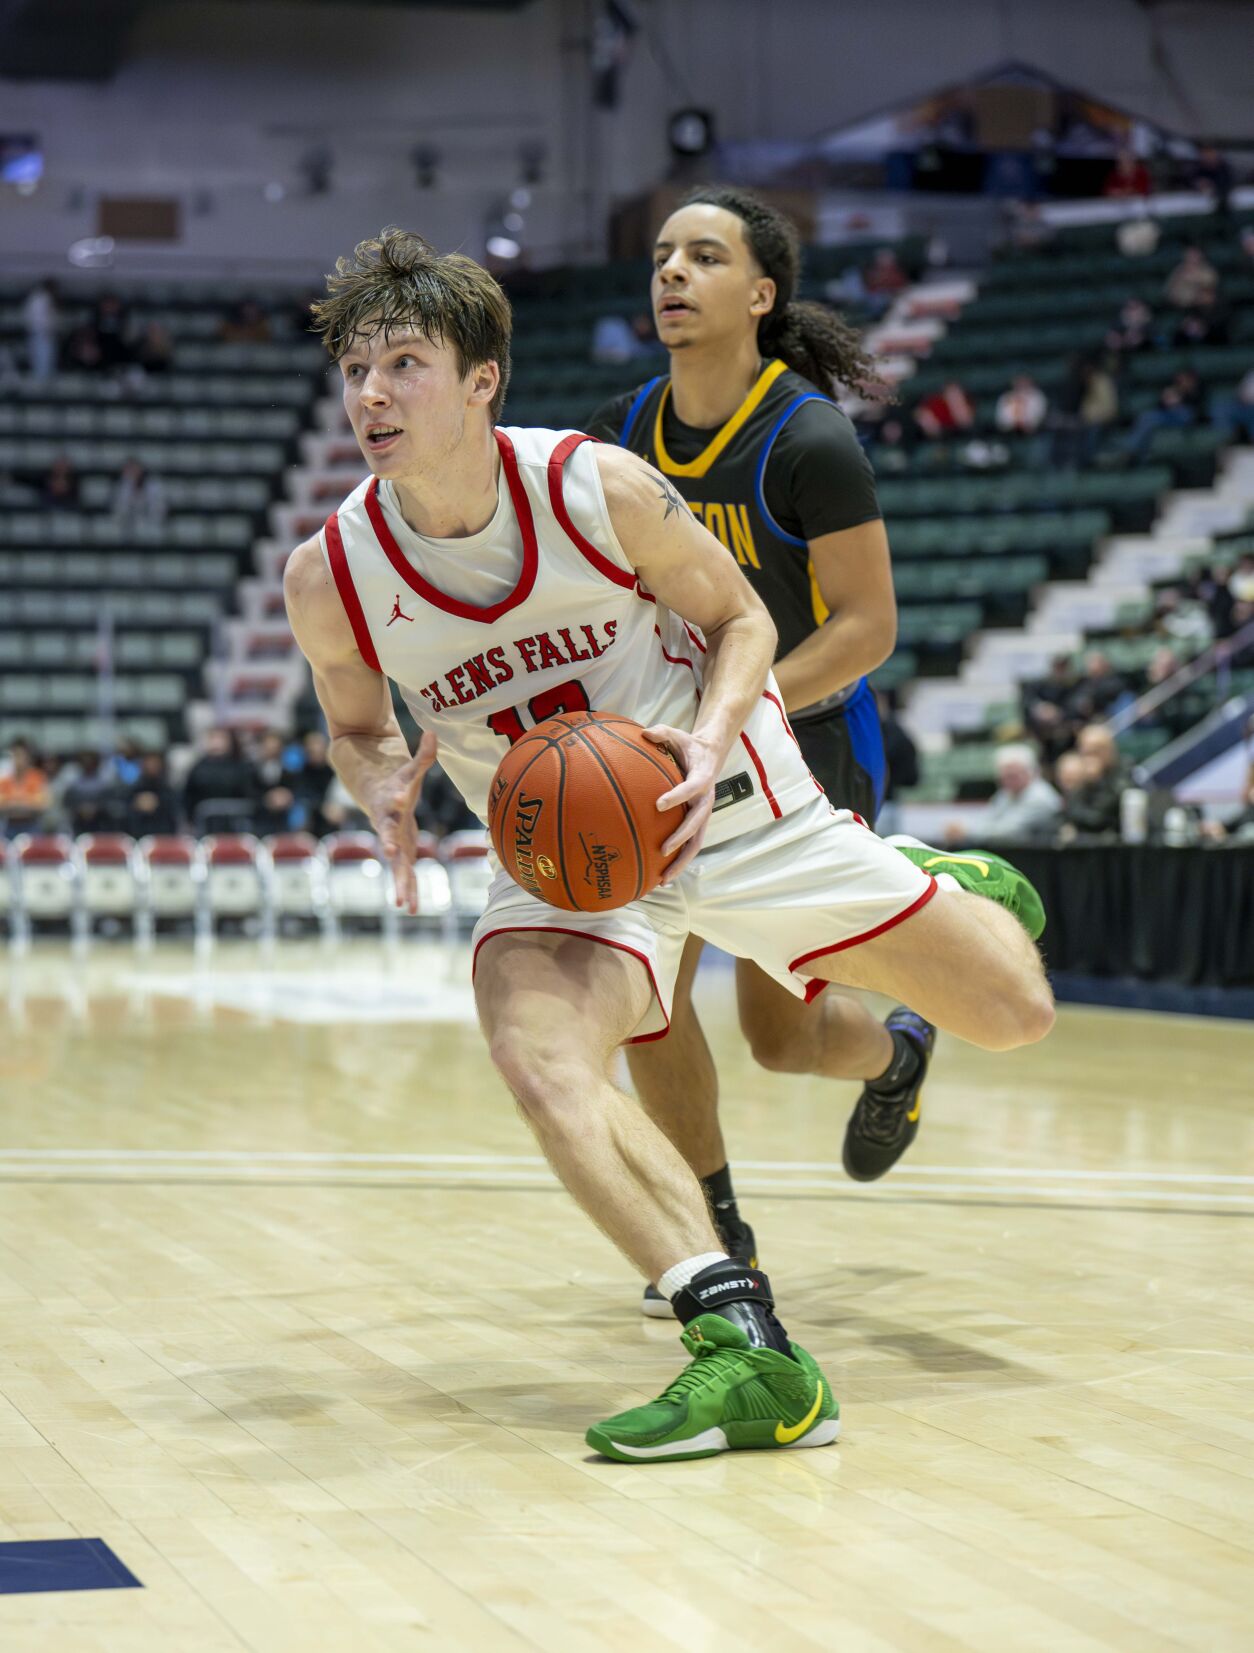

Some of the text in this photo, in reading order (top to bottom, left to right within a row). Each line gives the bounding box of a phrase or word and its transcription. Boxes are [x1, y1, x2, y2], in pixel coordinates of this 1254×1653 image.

[513, 620, 617, 673] FALLS
[737, 782, 747, 793] L
[515, 791, 548, 901] SPALDIN
[591, 845, 613, 899] NYSPHSAA
